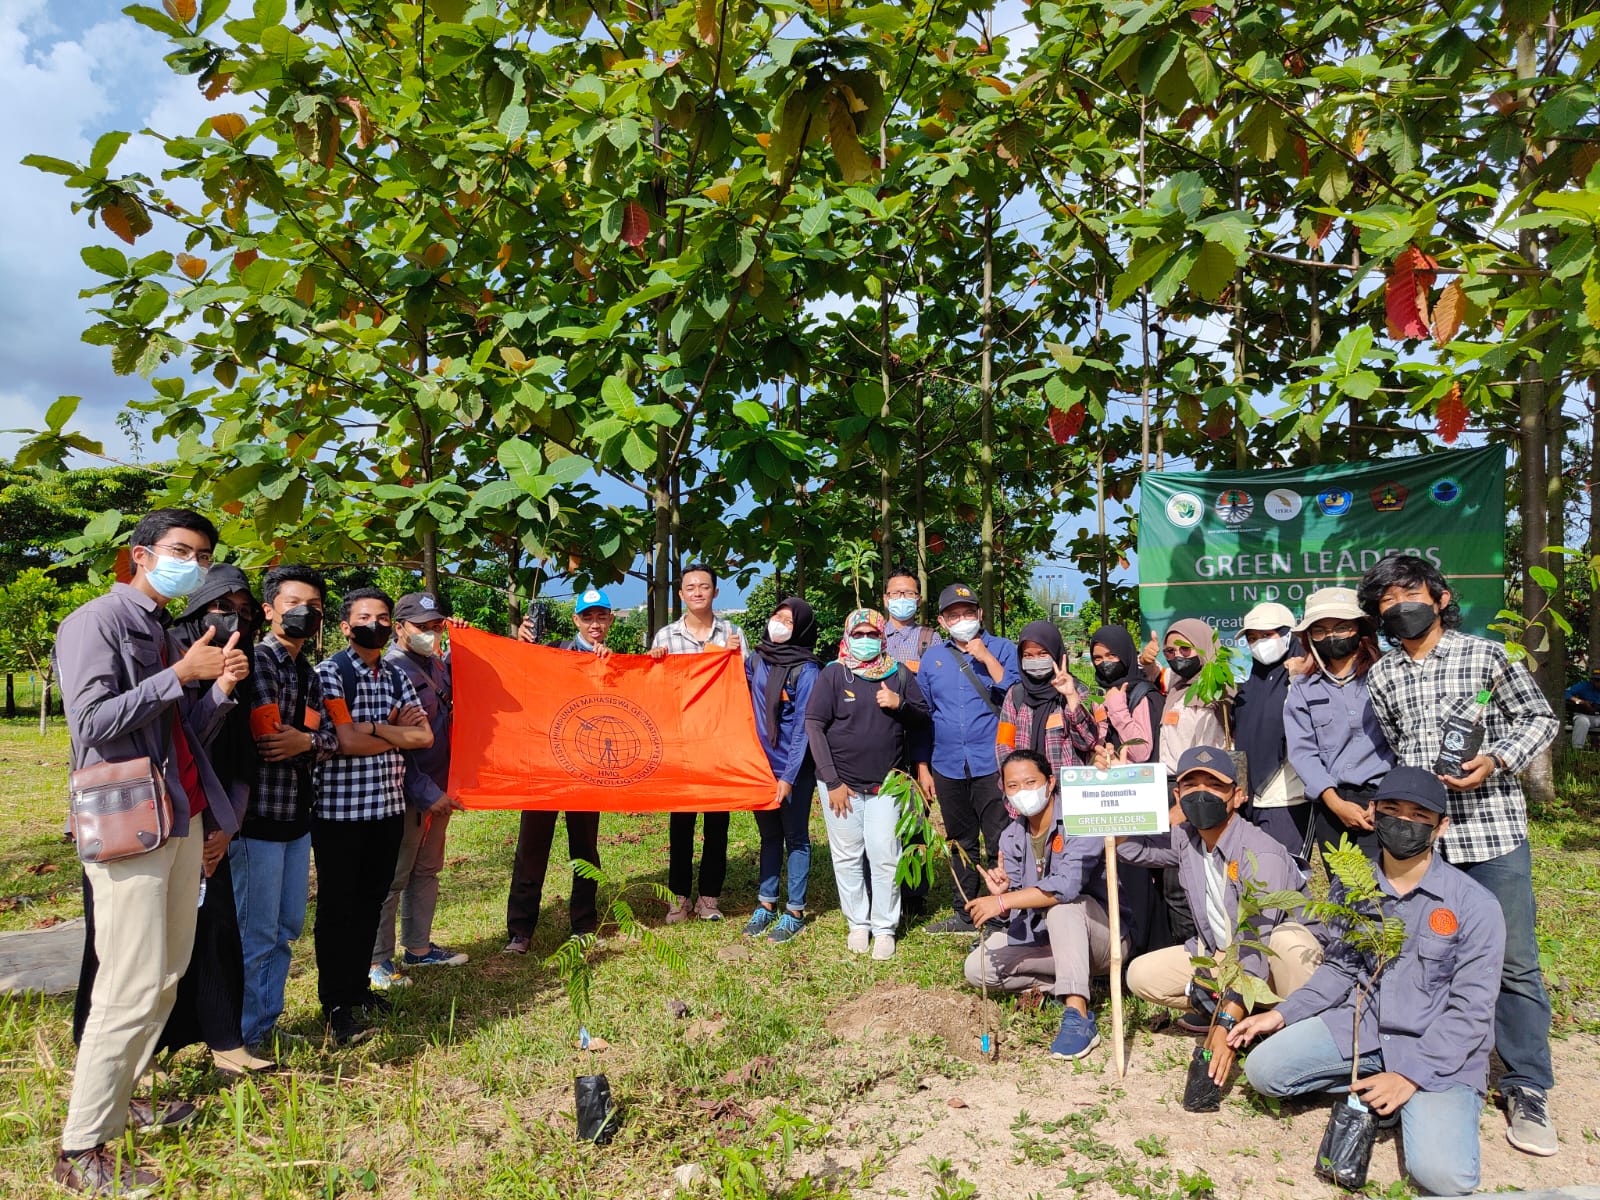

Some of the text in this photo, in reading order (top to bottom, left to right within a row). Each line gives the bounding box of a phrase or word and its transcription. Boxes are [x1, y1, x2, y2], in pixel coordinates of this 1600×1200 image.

[1195, 546, 1442, 577] GREEN LEADS
[553, 697, 660, 745] HIMPUNAN MAHASISWA GEOMATIKA
[553, 741, 660, 785] INSTITUT TEKNOLOGI SUMATERA
[1082, 789, 1137, 798] Hima Geomatika
[1078, 815, 1146, 825] GREEN LEADERS
